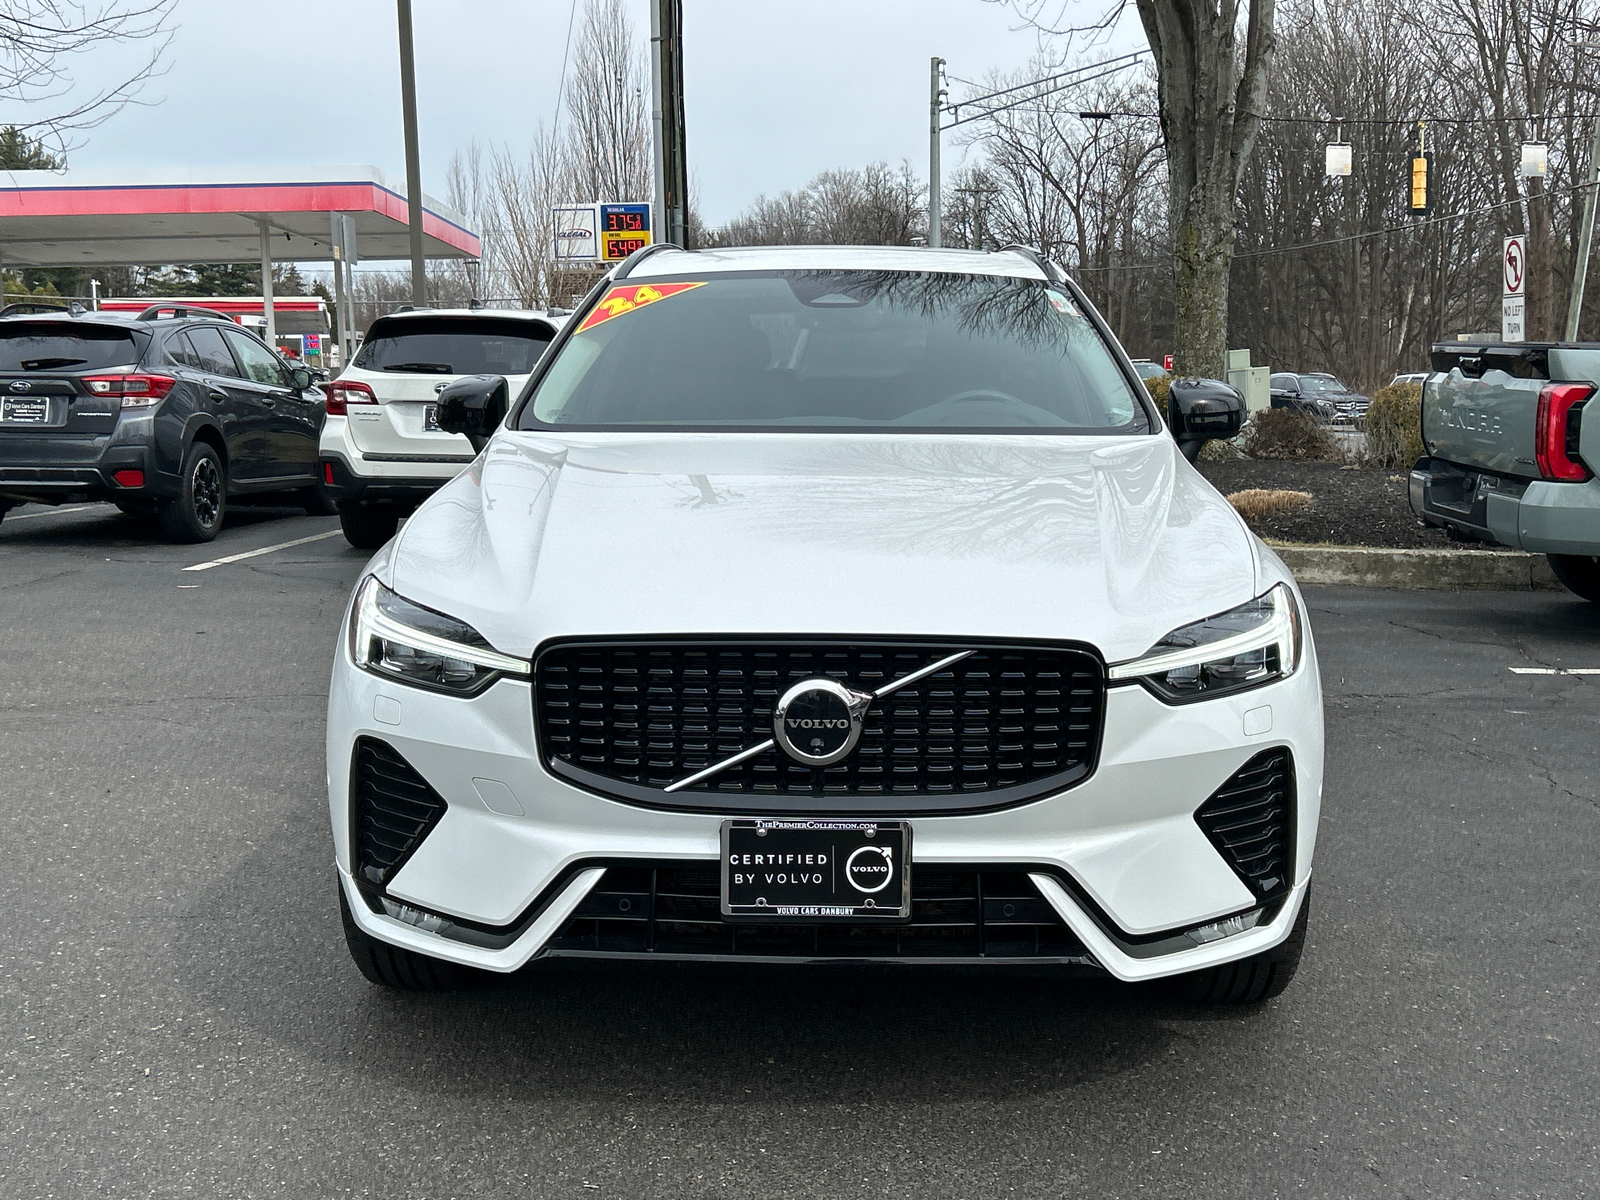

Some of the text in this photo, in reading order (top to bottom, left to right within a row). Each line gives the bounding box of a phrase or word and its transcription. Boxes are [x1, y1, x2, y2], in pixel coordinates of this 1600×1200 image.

[599, 285, 663, 316] 24
[1504, 305, 1523, 317] NO LEFT
[1507, 323, 1521, 334] TURN
[786, 718, 849, 729] VOLVO
[729, 854, 828, 865] CERTIFIED
[734, 873, 823, 884] BY VOLVO
[776, 907, 854, 916] VOLVO CARS DANBURY
